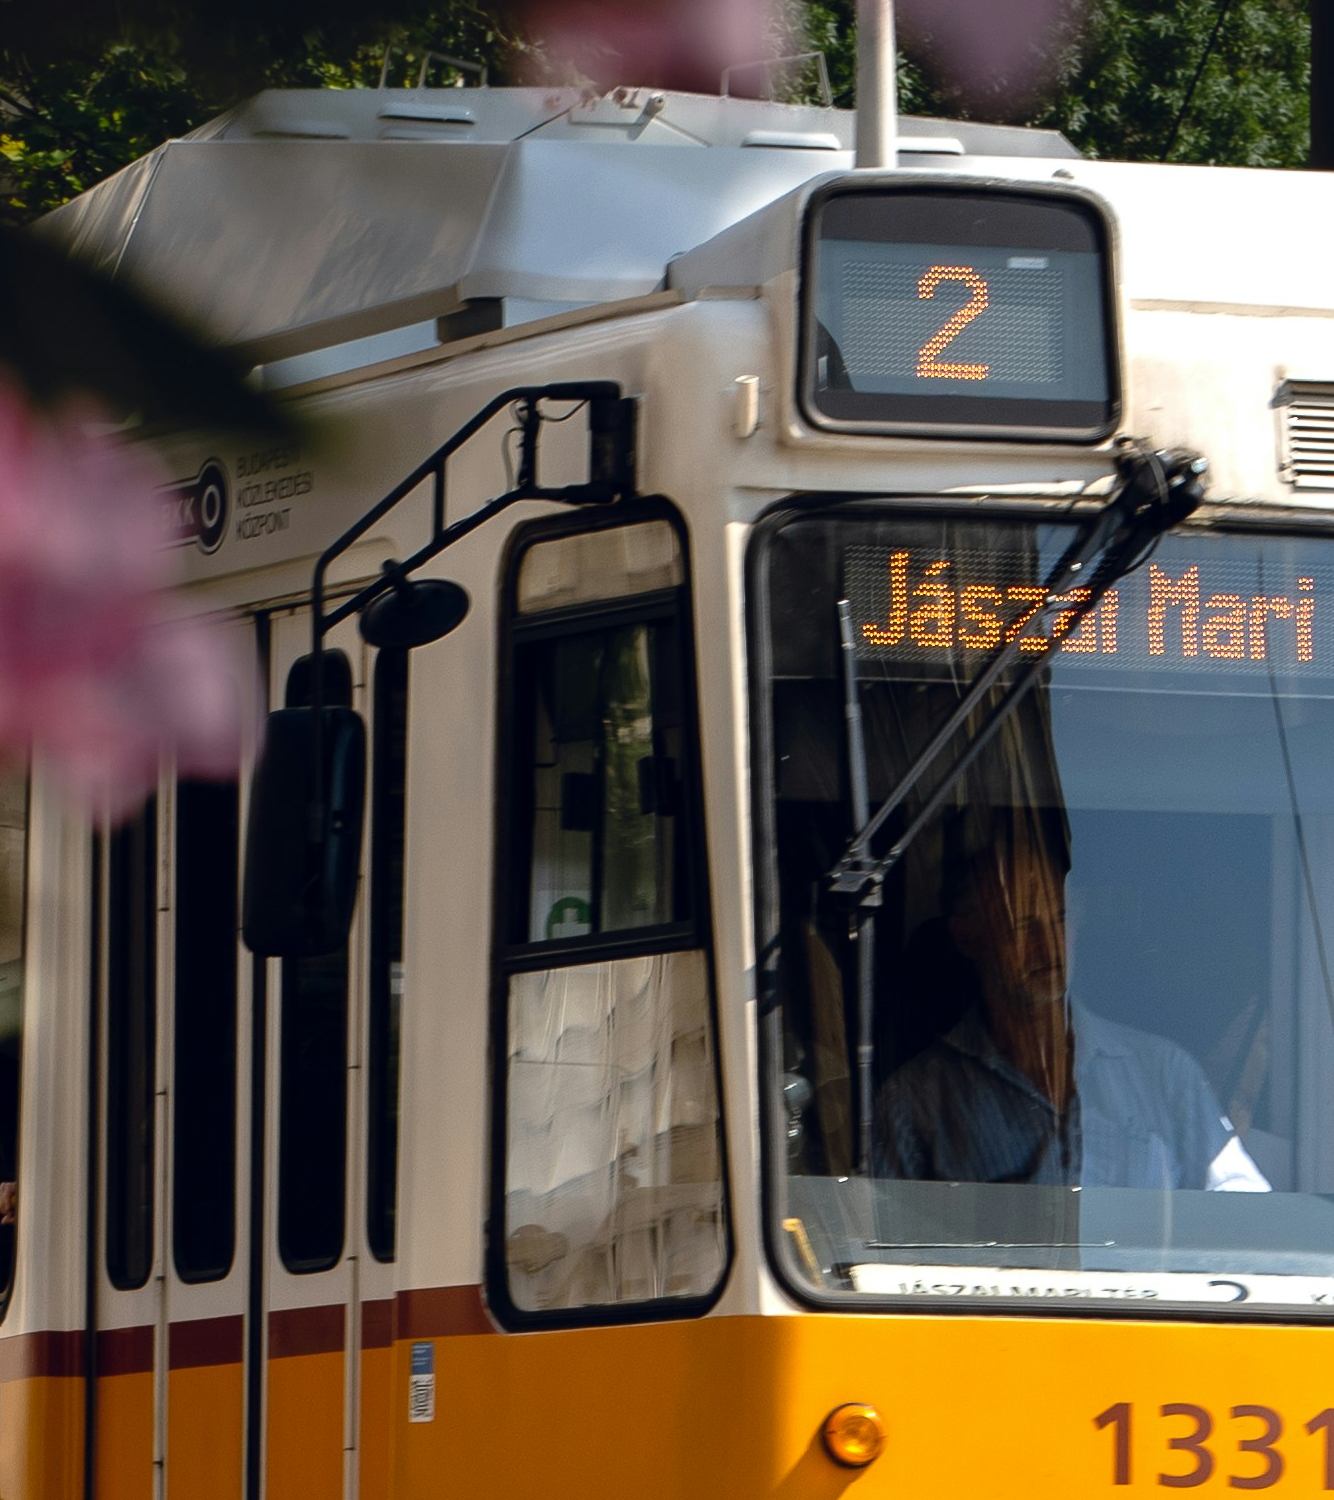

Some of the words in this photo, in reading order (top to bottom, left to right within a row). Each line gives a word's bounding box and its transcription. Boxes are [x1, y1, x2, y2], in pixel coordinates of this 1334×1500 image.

[916, 264, 990, 380] 2
[861, 551, 1119, 654] Jászai
[1147, 563, 1315, 664] Mari
